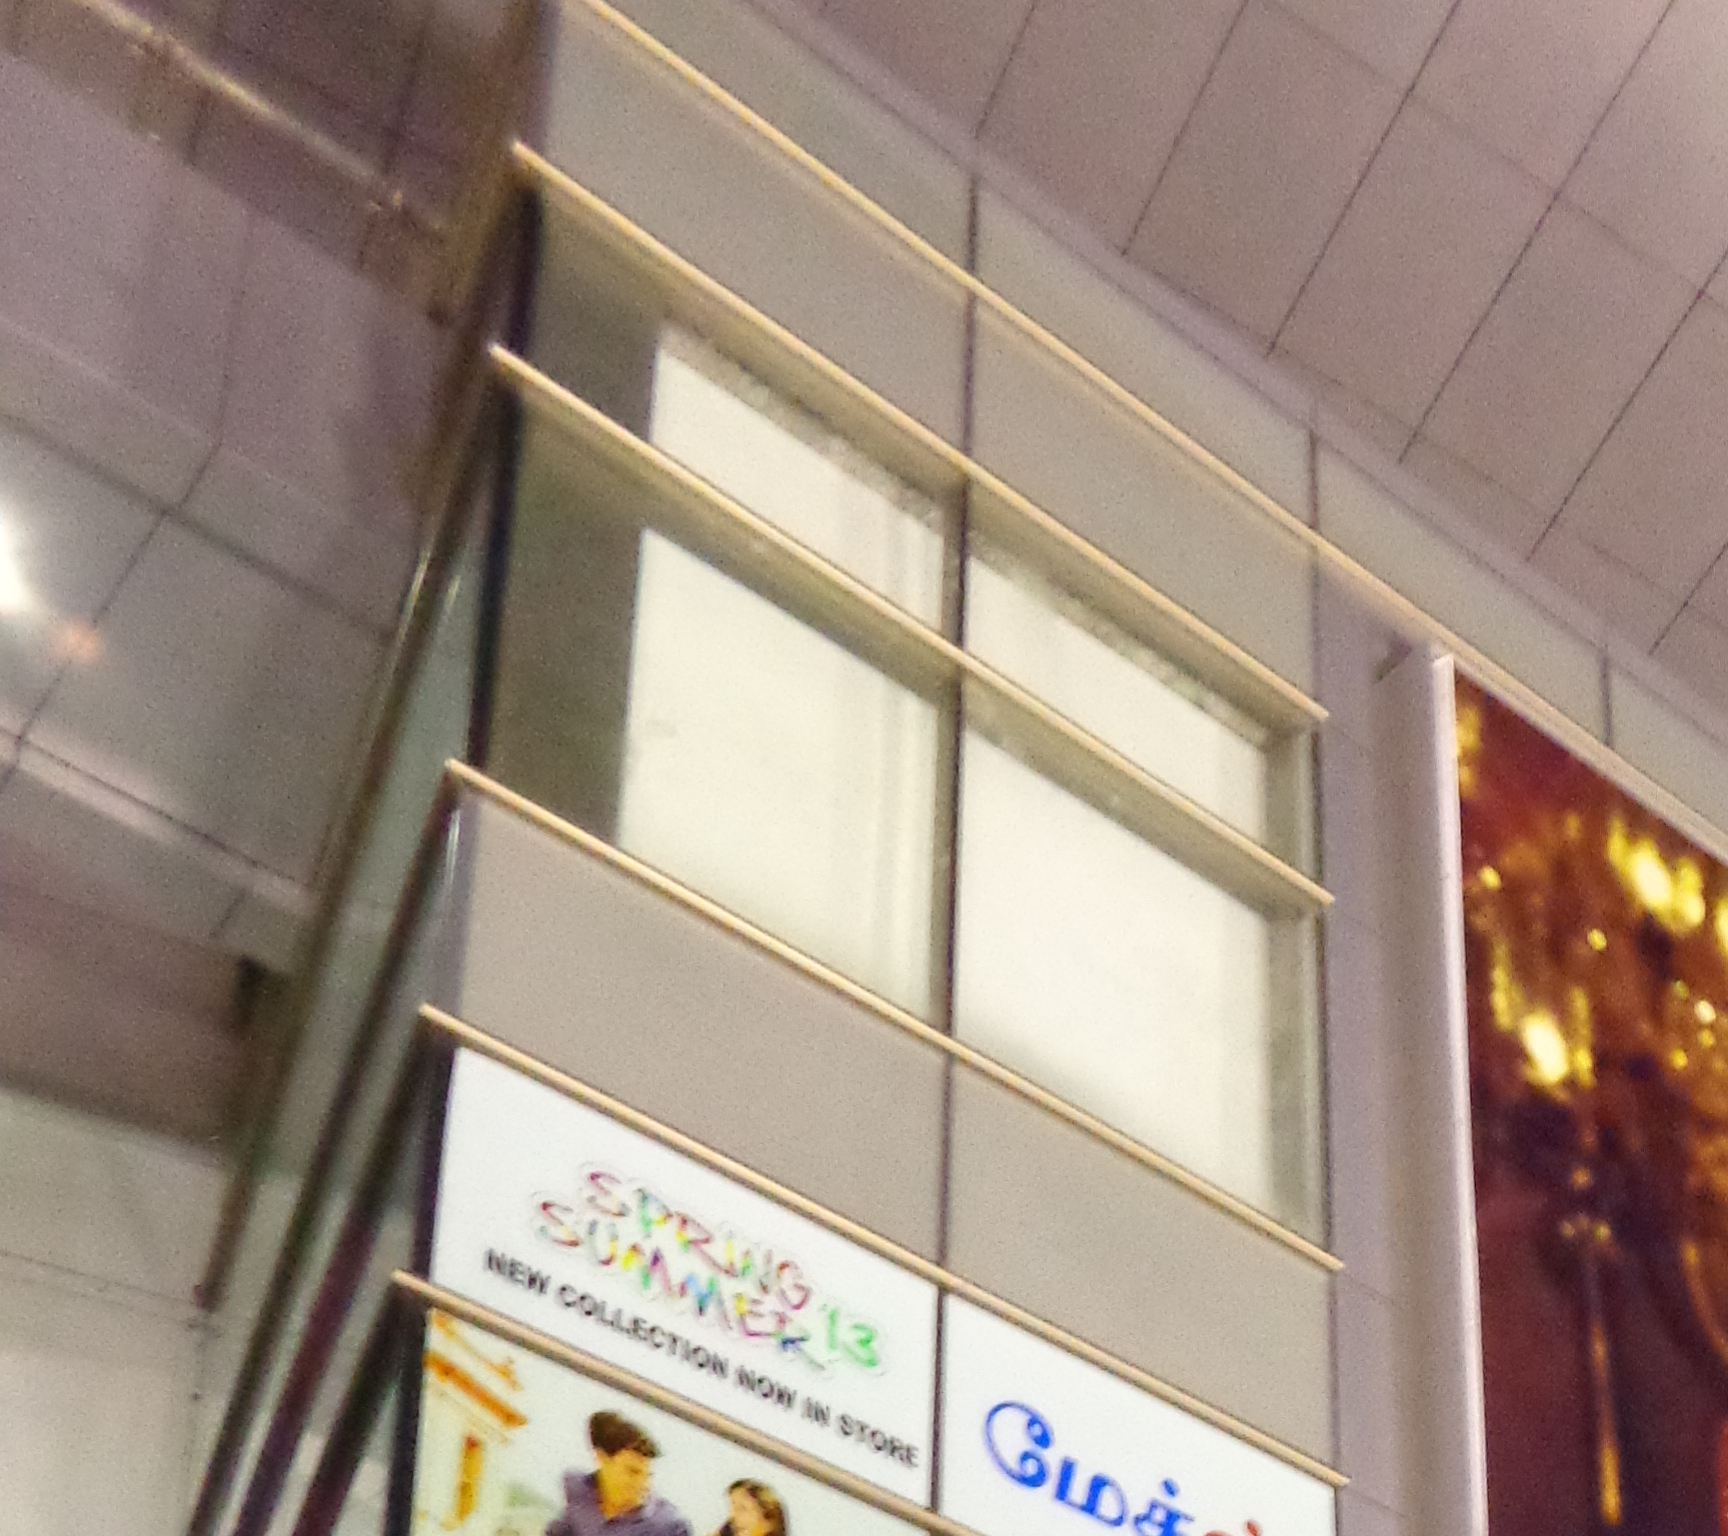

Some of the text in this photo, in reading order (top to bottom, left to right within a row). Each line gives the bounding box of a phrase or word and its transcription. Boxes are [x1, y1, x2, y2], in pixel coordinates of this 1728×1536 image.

[485, 1247, 920, 1469] NEW COLLECTION NOW IN STORE
